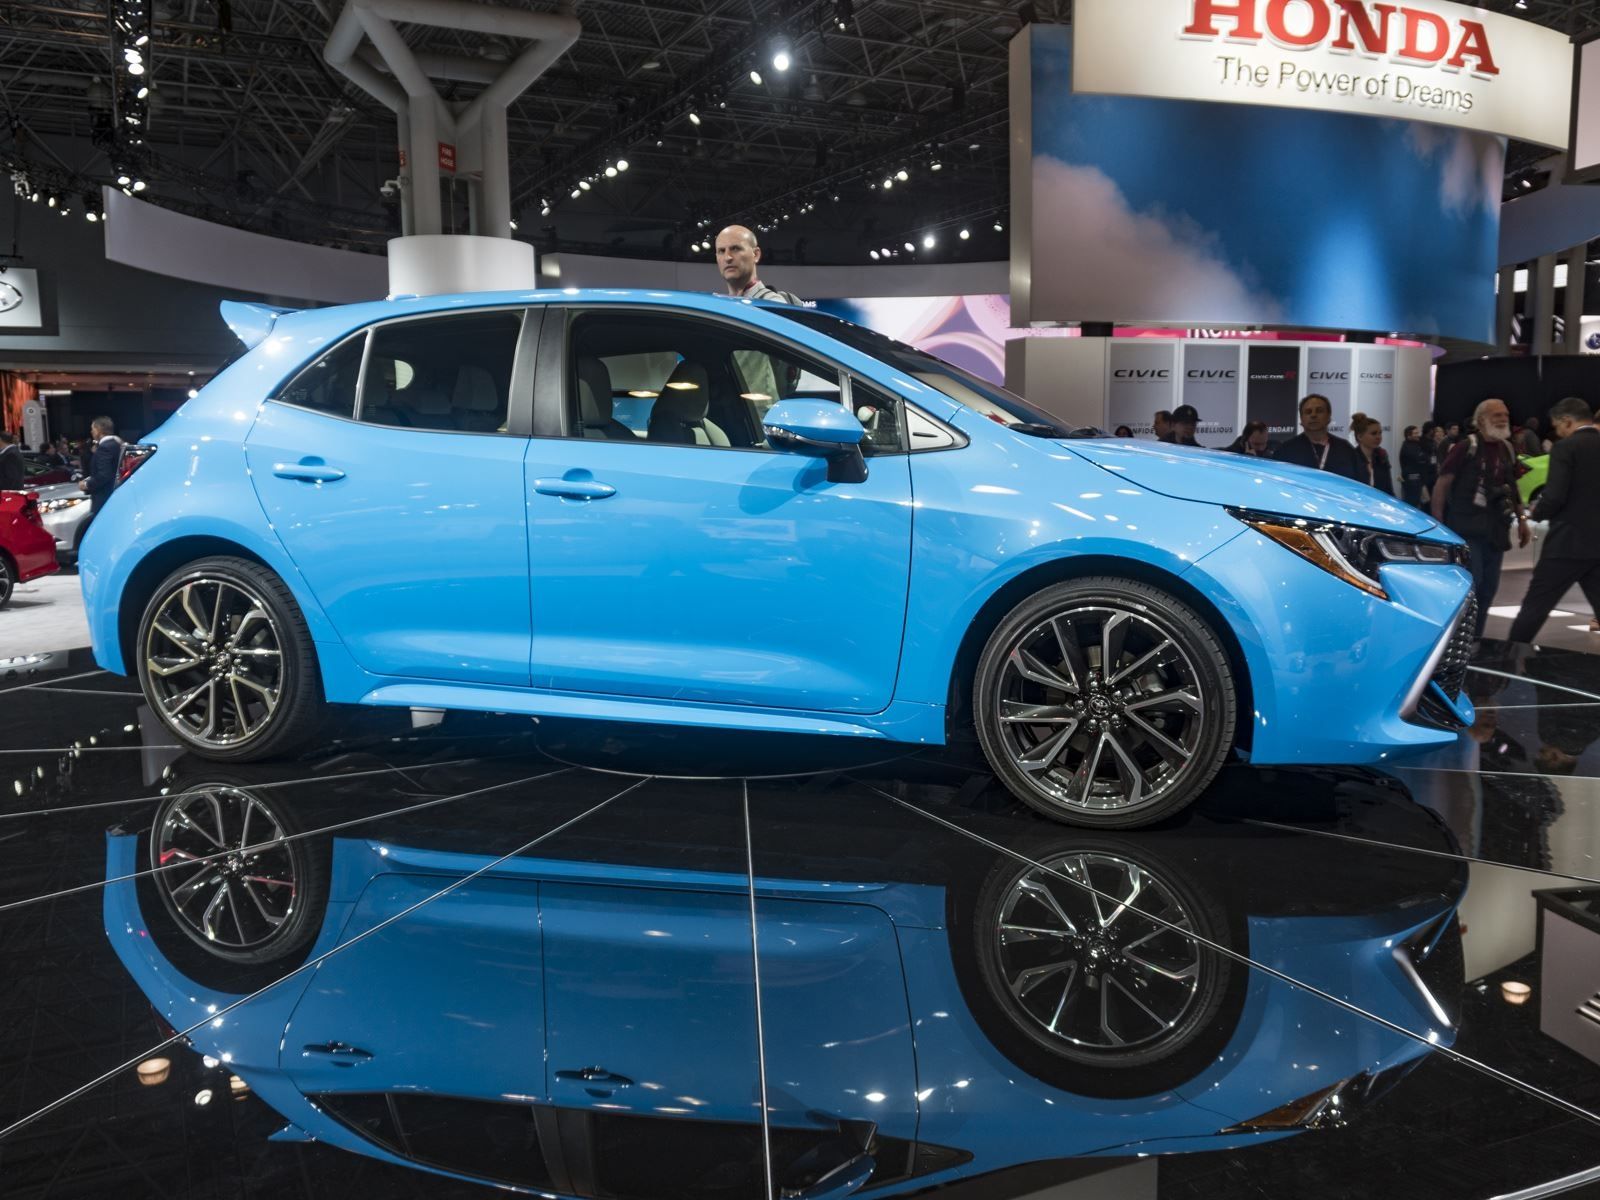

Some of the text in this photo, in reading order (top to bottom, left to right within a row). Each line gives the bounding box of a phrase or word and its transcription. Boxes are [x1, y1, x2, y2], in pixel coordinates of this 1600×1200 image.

[1184, 0, 1499, 74] HONDA
[1217, 56, 1473, 110] The Power of Dreams
[1114, 369, 1169, 378] CIVIC
[1187, 370, 1236, 378] CIVIC
[1310, 371, 1349, 380] CIVIC
[1199, 426, 1233, 434] EBELLIOUS
